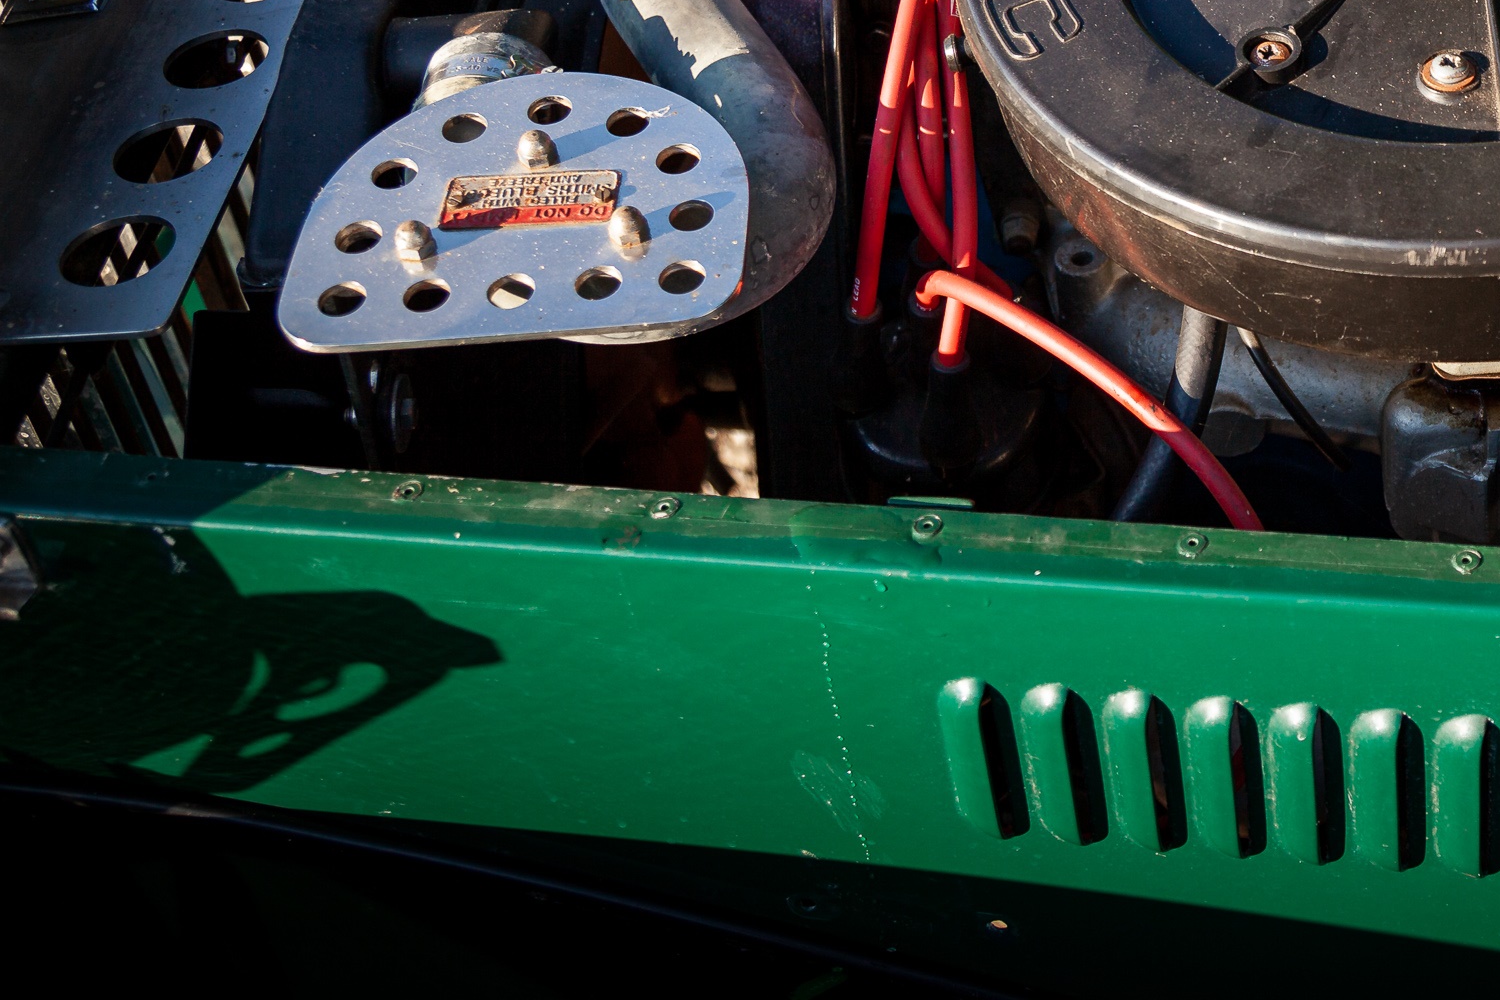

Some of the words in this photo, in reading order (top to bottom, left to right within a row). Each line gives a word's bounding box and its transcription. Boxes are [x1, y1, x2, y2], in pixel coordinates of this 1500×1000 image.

[480, 197, 521, 209] WITH
[534, 207, 571, 219] NOT
[580, 205, 608, 218] DO
[852, 277, 861, 302] LEAD
